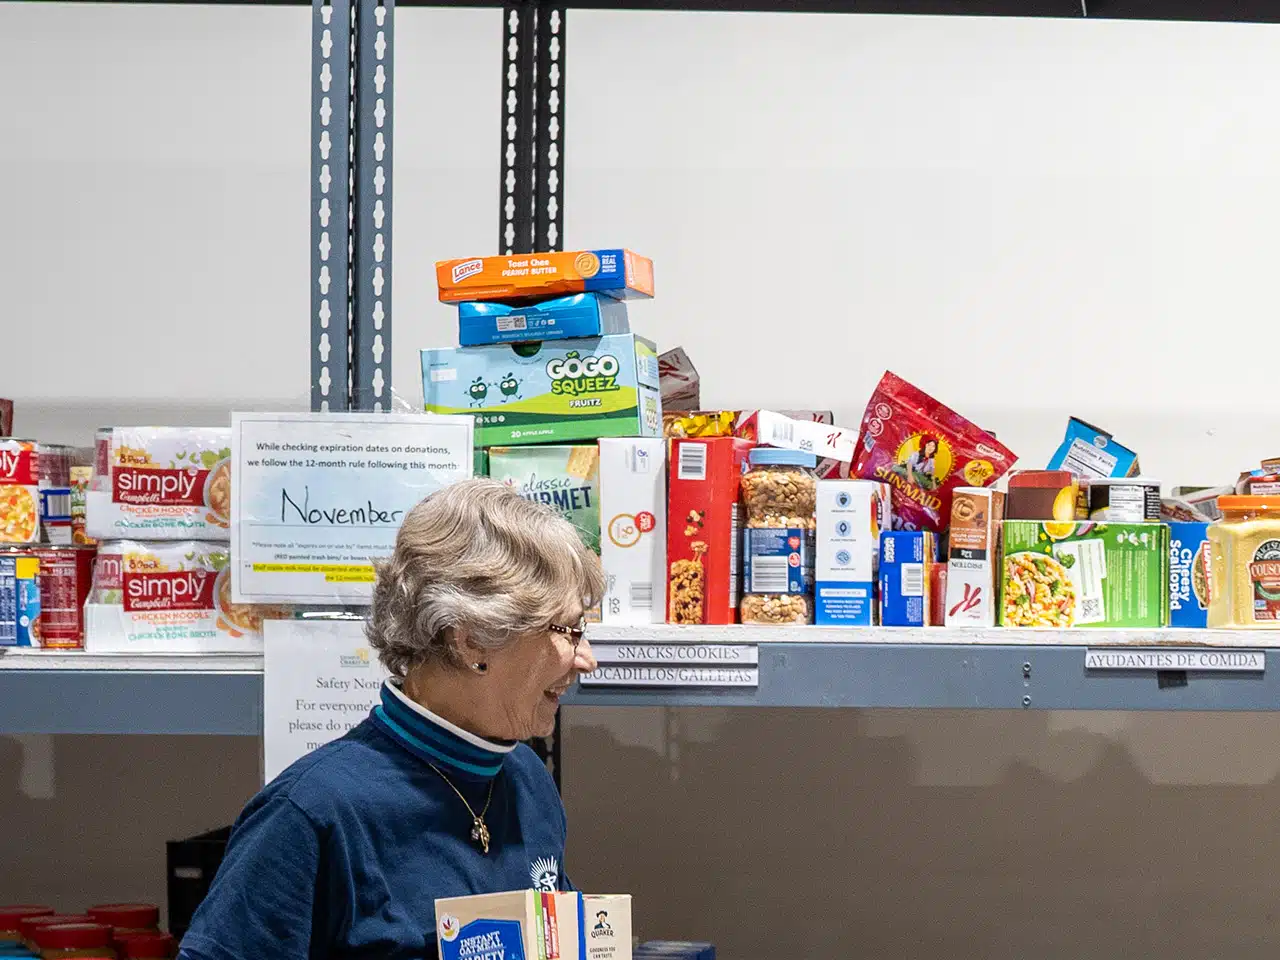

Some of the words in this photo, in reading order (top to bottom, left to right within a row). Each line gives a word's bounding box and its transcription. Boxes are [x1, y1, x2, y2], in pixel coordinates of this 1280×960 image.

[454, 261, 482, 279] Lance
[546, 354, 620, 380] GOGO
[569, 398, 602, 408] FRUITZ
[511, 430, 522, 438] 20
[256, 443, 280, 451] While
[282, 443, 318, 454] checking
[320, 444, 364, 455] expiration
[366, 444, 389, 453] dates
[404, 445, 450, 456] donations,
[247, 459, 260, 467] we
[262, 458, 287, 467] follow
[289, 459, 303, 467] the
[306, 459, 346, 468] 12-month
[349, 459, 365, 468] rule
[368, 460, 408, 471] following
[410, 461, 426, 470] this
[118, 470, 197, 499] simply
[523, 472, 572, 493] classic
[281, 485, 404, 525] November
[1170, 540, 1182, 610] Scalloped
[1180, 548, 1192, 602] Cheesy
[128, 573, 206, 602] simply
[618, 646, 740, 660] SNACKS/COOKIES
[1088, 653, 1173, 666] AYUDANTES
[1177, 653, 1197, 666] DE
[1200, 653, 1259, 667] COMIDA
[316, 677, 350, 693] Safety
[354, 678, 381, 690] Noti
[296, 699, 316, 711] For
[319, 700, 373, 715] everyone'
[288, 719, 323, 734] please
[326, 719, 341, 731] do
[459, 931, 501, 948] INSTANT
[590, 929, 615, 938] QUAKER
[459, 941, 505, 956] OATMEAL
